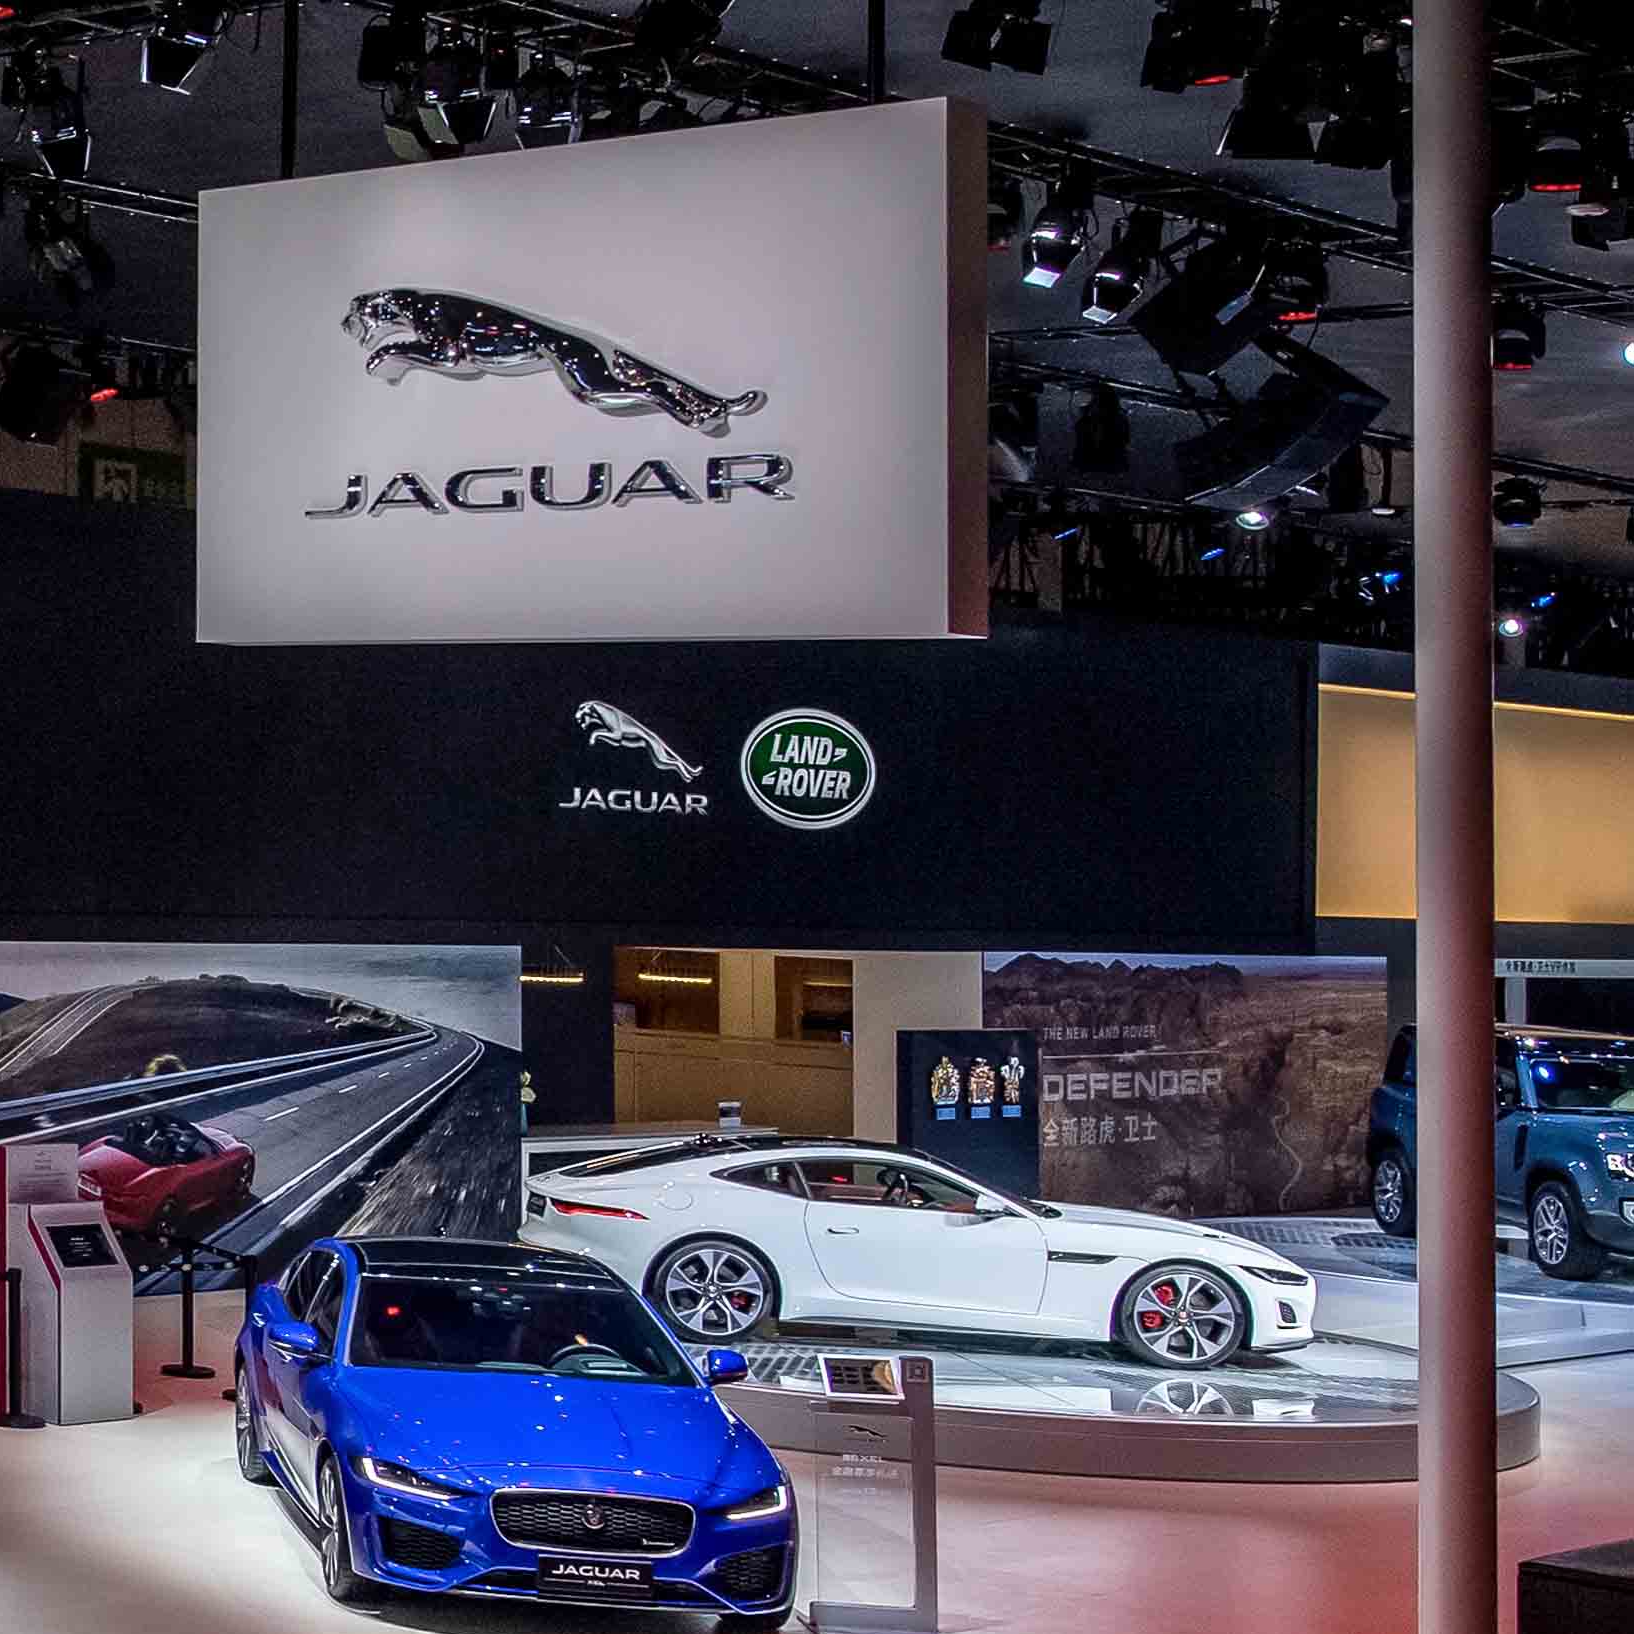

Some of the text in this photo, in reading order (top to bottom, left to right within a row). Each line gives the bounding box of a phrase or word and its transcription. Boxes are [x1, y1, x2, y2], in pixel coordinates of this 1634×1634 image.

[305, 452, 796, 520] JAGUAR
[770, 733, 834, 766] LAND
[774, 767, 851, 799] ROVER
[558, 787, 708, 816] JAGUAR
[1043, 1024, 1156, 1041] THE NEW LAND ROVER
[1042, 1068, 1222, 1102] DEFENDER
[551, 1564, 640, 1581] JAGUAR
